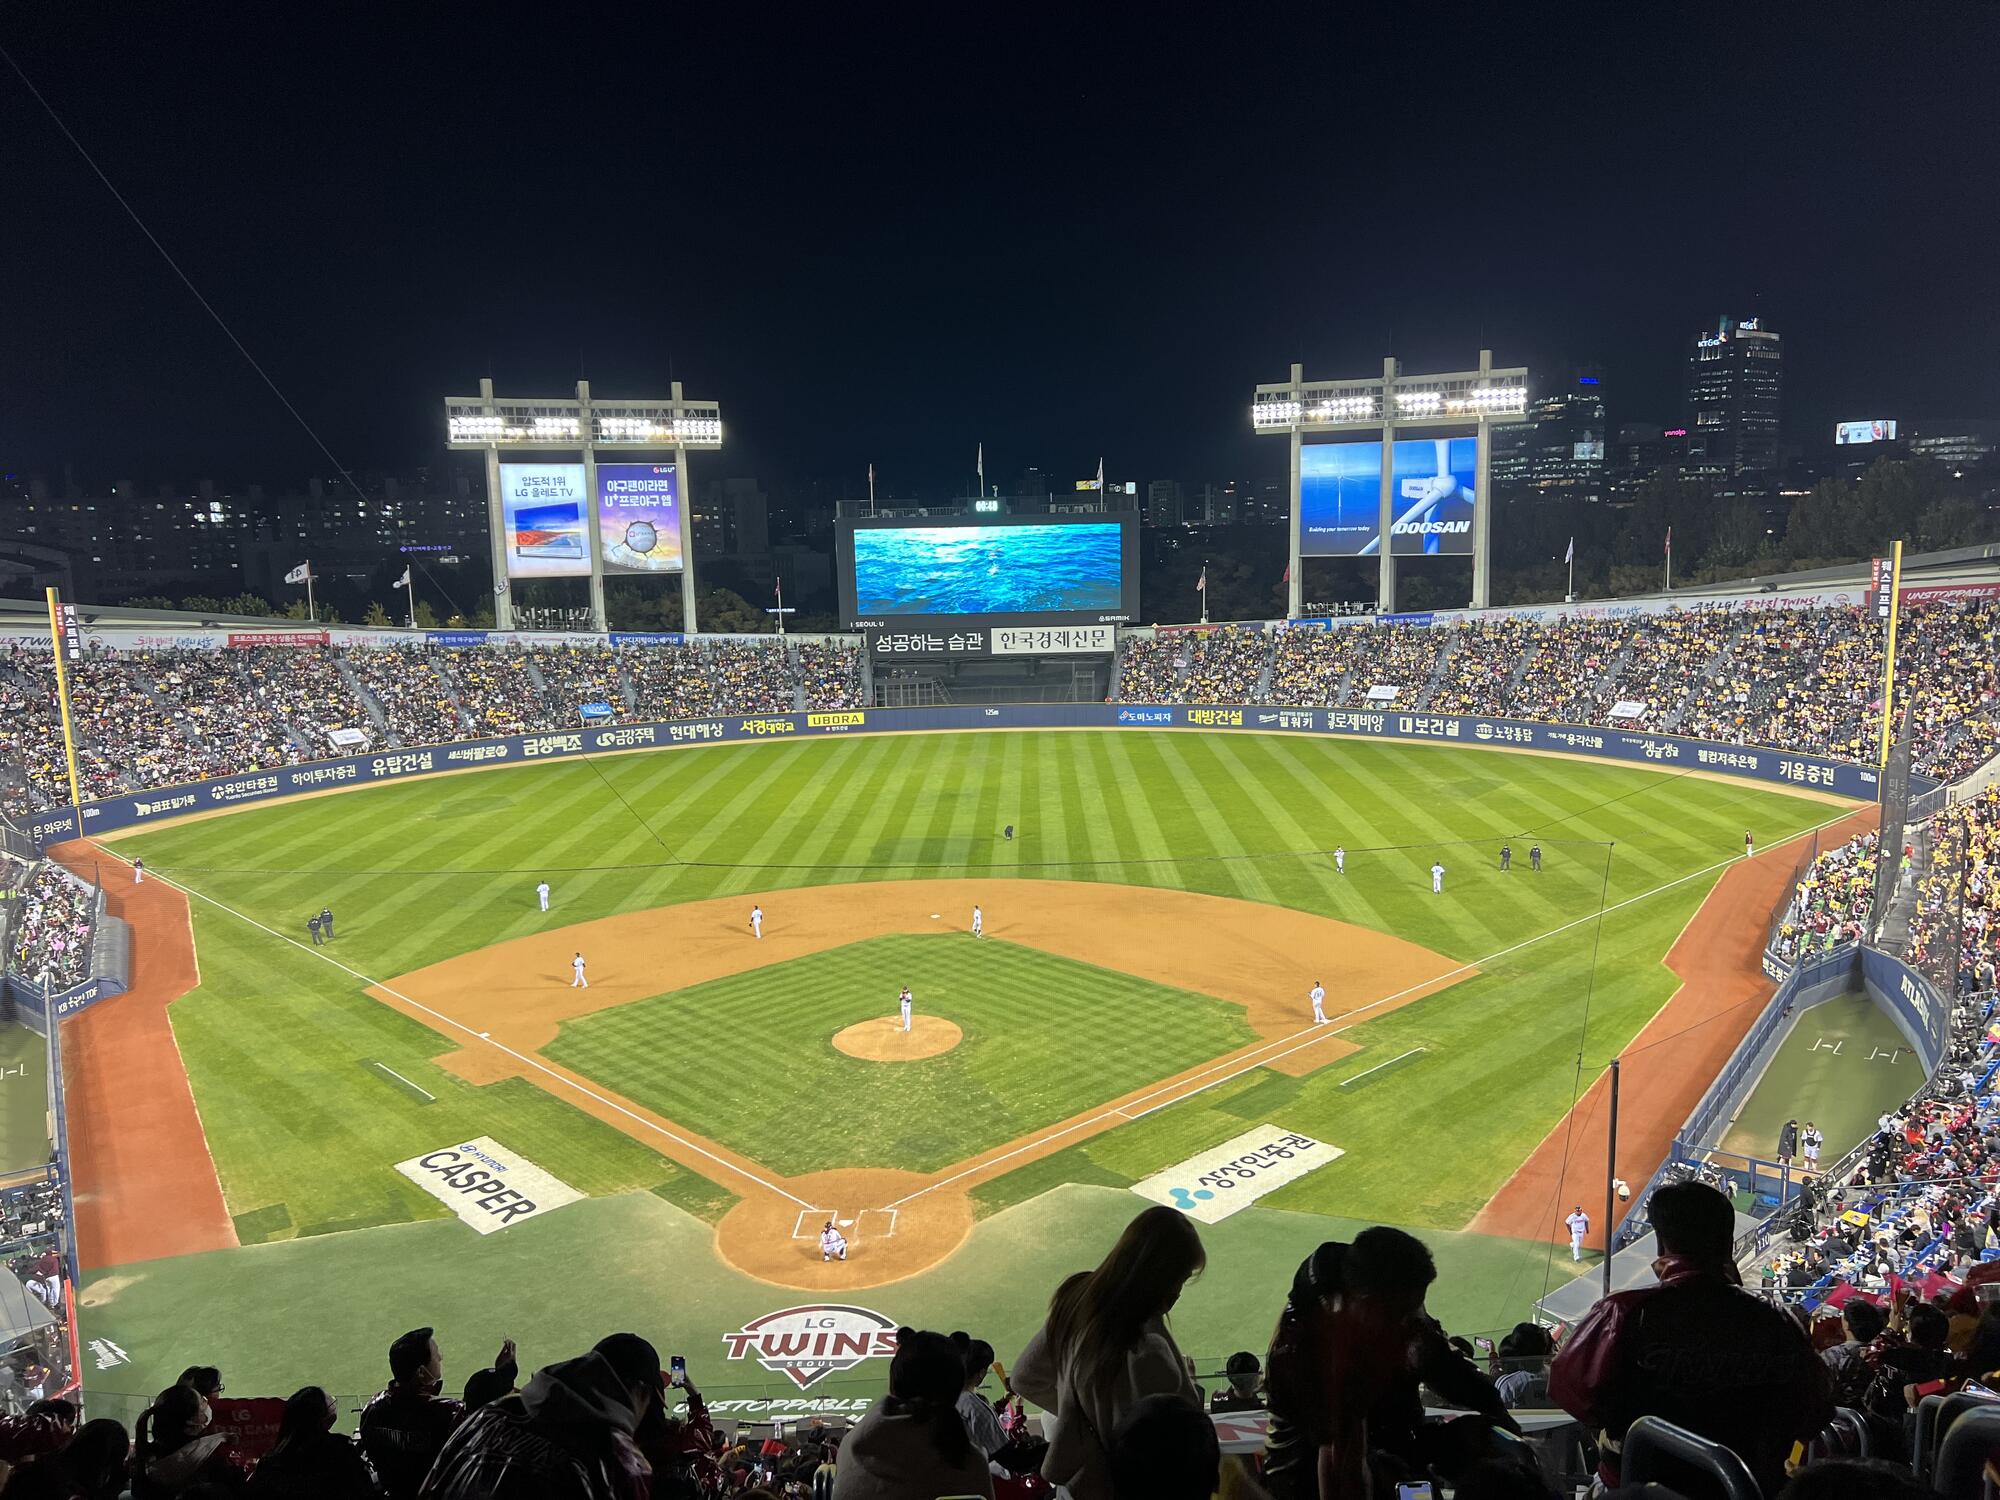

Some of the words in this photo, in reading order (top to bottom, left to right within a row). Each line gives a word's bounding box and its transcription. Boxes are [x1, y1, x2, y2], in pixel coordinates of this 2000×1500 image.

[1664, 429, 1686, 437] yanolja
[522, 476, 550, 487] 압도적
[552, 476, 566, 487] 1위
[606, 479, 668, 492] 야구팬이라면
[515, 488, 528, 497] LG
[532, 487, 559, 498] 올레드
[561, 487, 573, 497] TV
[604, 494, 618, 508] U+
[619, 495, 660, 507] 프로야구
[1395, 520, 1471, 534] DOOSAN
[1781, 596, 1822, 608] TWINS!
[1906, 587, 1996, 601] UNSTOPPABLE
[876, 634, 944, 653] 성공하는
[947, 632, 983, 652] 습관
[1000, 630, 1106, 650] 한국경제신문
[813, 715, 859, 726] UBORA
[1129, 712, 1171, 723] 도미노피자
[1188, 709, 1243, 726] 대방건설
[1279, 716, 1313, 729] 밀워키
[670, 722, 723, 741] 현대해상
[740, 719, 795, 735] 서경대학교
[1399, 717, 1459, 737] 대보건설
[523, 734, 582, 756] 금성백조
[615, 727, 654, 747] 금강주택
[1640, 740, 1679, 759] 생글생글
[371, 752, 433, 777] 유탑건설
[1698, 749, 1758, 771] 웰컴저축은행
[292, 764, 356, 786] 하이투자증권
[1779, 760, 1834, 787] 키움증권
[1860, 771, 1877, 783] 100m
[225, 776, 278, 793] 유안타증권
[82, 807, 100, 819] 100m
[474, 1152, 509, 1173] HYUNDAI
[1198, 1133, 1316, 1189] 상상인증권
[419, 1151, 537, 1224] CASPER
[804, 1317, 836, 1329] LG
[724, 1331, 899, 1359] TWINS
[786, 1360, 835, 1368] SEOUL
